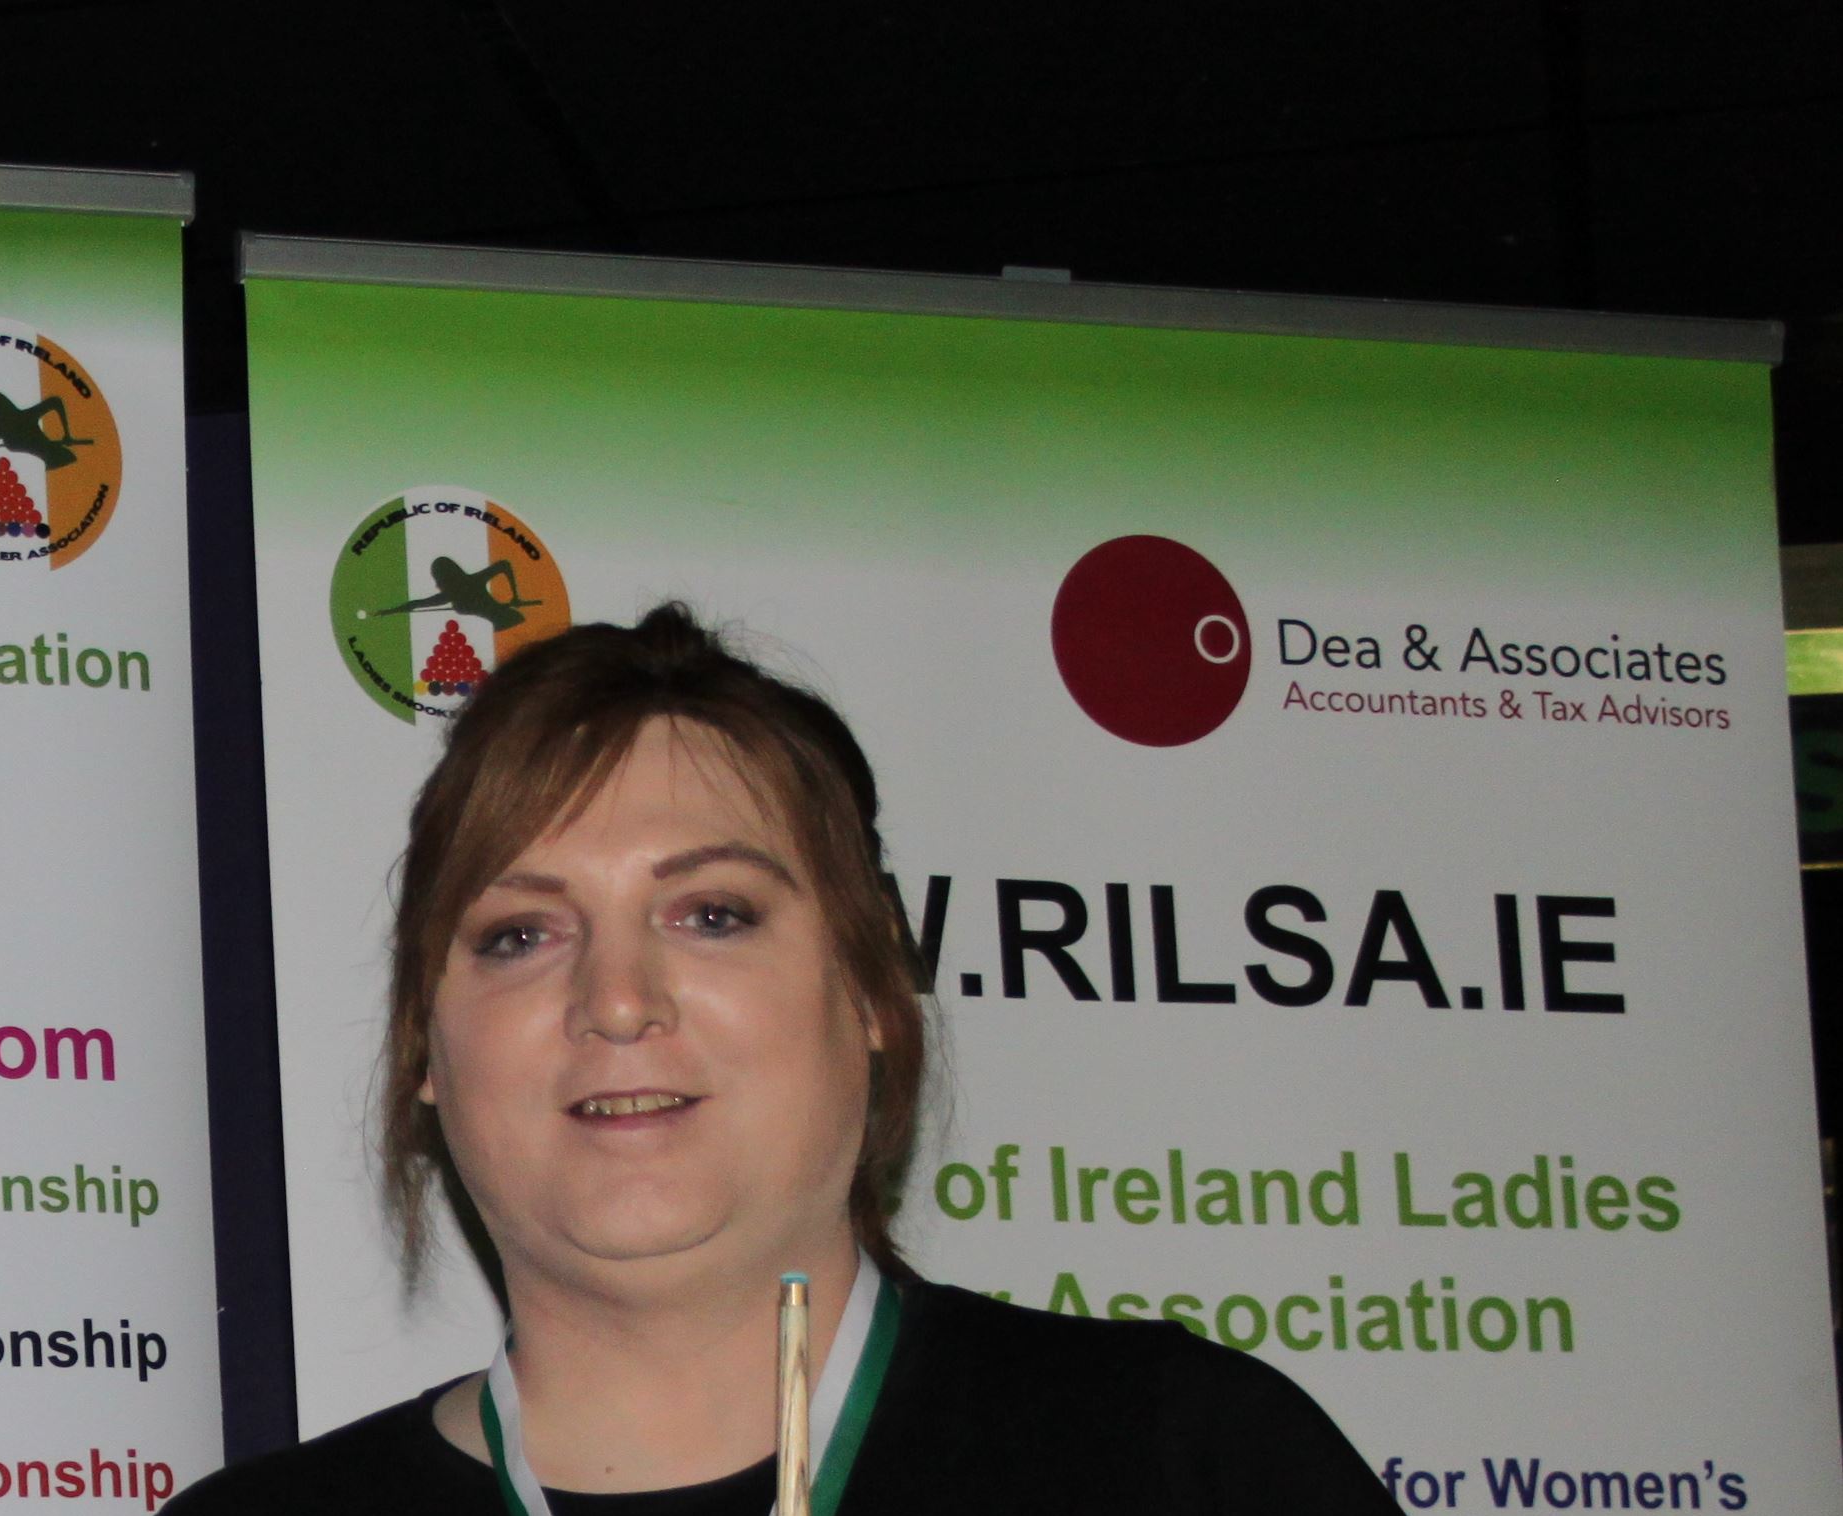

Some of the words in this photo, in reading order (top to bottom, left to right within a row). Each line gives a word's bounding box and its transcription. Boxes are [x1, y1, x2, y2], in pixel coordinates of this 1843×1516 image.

[15, 339, 91, 399] IRELAND
[28, 484, 109, 559] ASSOCIATION
[352, 504, 431, 556] REPUBLIC
[435, 502, 460, 514] OF
[464, 507, 540, 561] IRELAND
[348, 636, 391, 693] LADIES
[392, 691, 457, 718] SNOOK
[1279, 620, 1382, 670] Dea
[1404, 625, 1443, 672] &
[1461, 628, 1728, 686] Associates
[1285, 682, 1488, 719] Accountants
[1500, 690, 1523, 720] &
[1533, 692, 1588, 722] Tax
[1599, 695, 1731, 730] Advisors
[934, 1145, 1021, 1222] of
[1050, 1147, 1362, 1228] Ireland
[1395, 1153, 1683, 1234] Ladies
[1381, 1458, 1467, 1508] for
